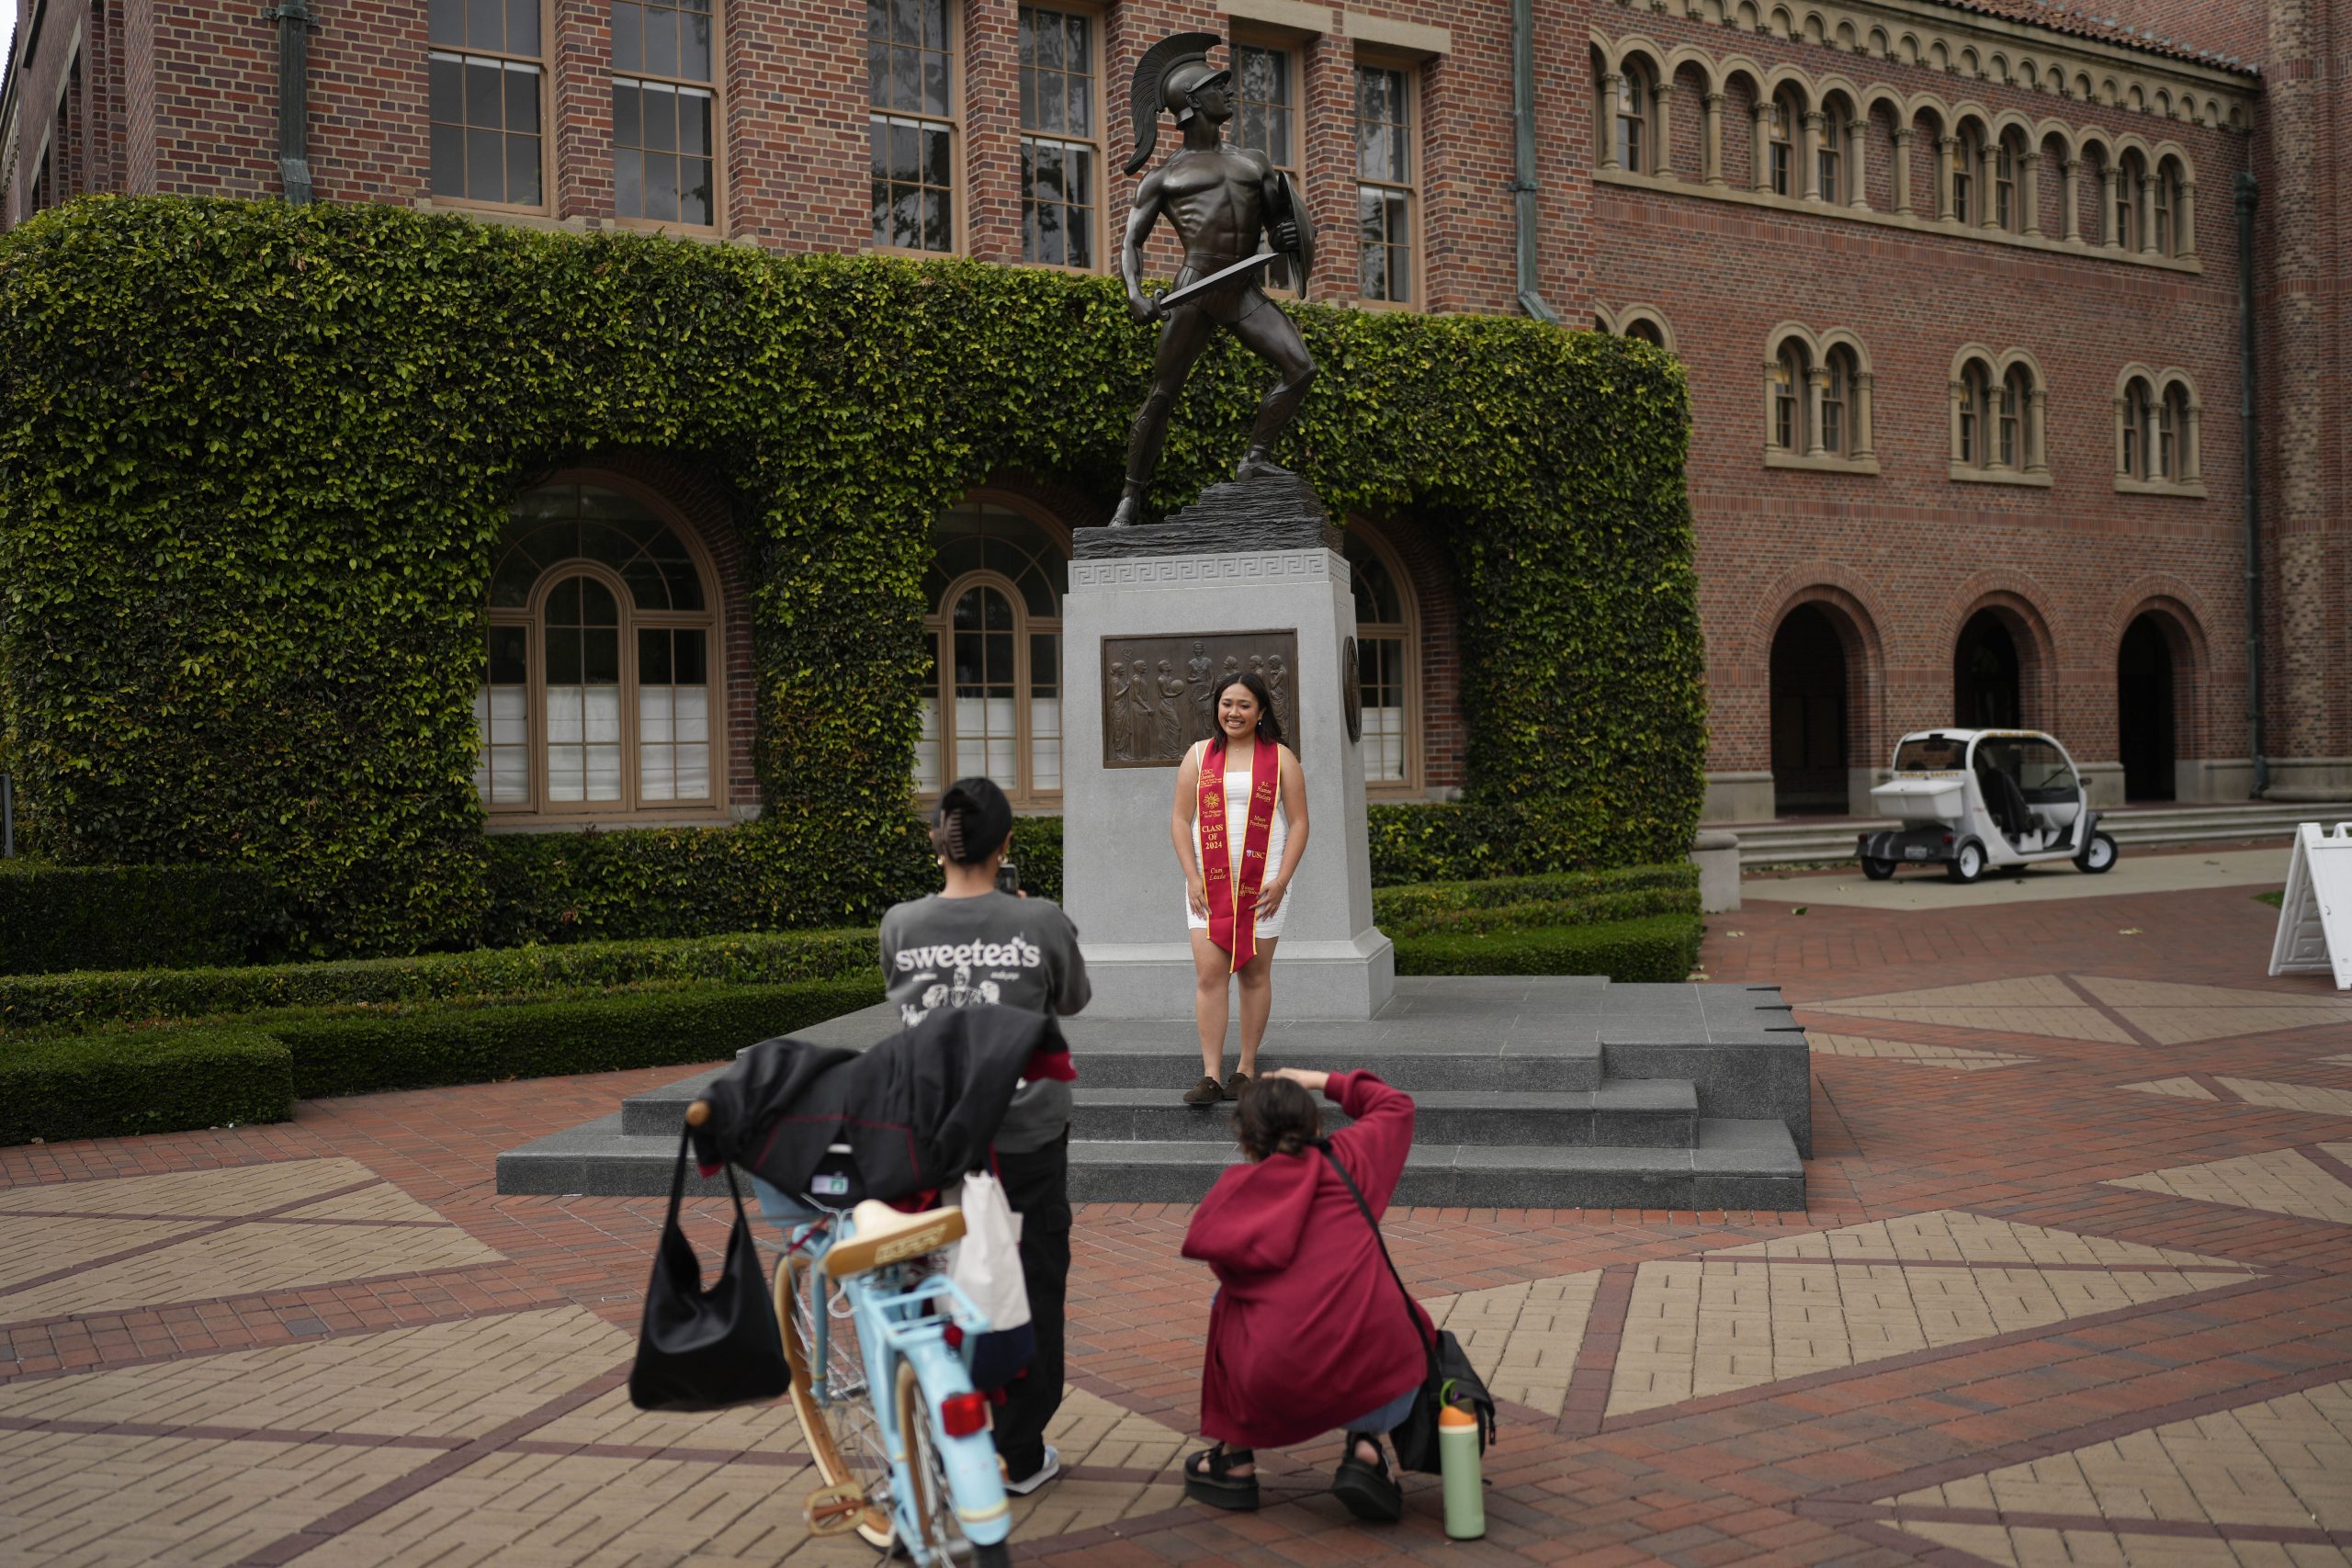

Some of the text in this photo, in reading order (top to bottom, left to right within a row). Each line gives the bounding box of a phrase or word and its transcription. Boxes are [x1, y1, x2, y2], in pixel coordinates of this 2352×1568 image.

[1255, 792, 1272, 802] Biology
[1202, 824, 1224, 833] CLASS
[1205, 841, 1223, 850] 2024
[1251, 851, 1265, 859] USC
[1209, 873, 1227, 881] Laude
[895, 935, 1041, 972] sweetea's
